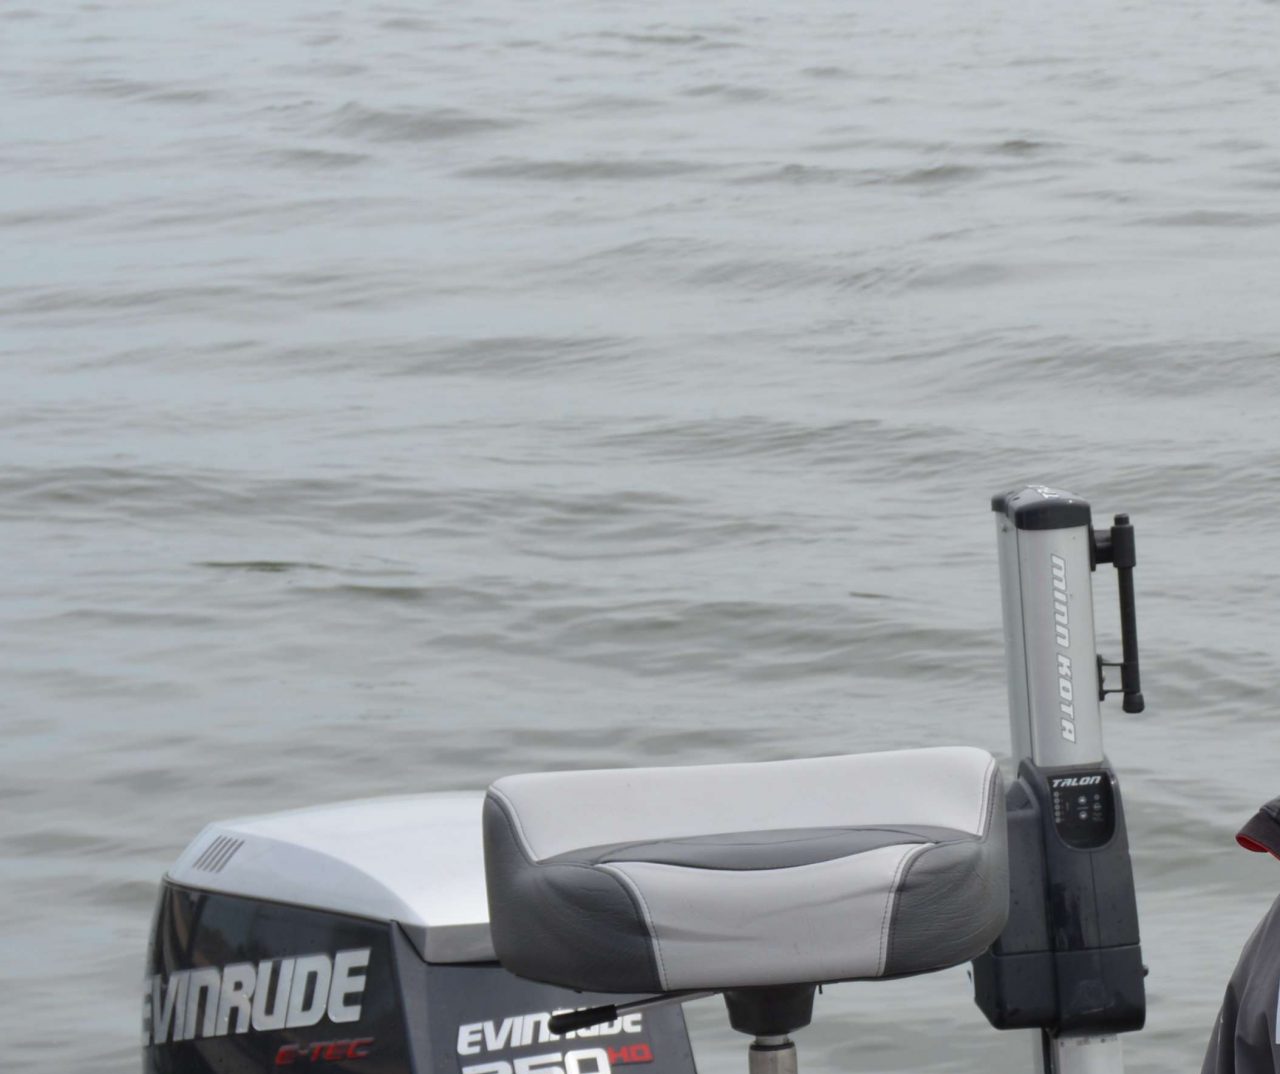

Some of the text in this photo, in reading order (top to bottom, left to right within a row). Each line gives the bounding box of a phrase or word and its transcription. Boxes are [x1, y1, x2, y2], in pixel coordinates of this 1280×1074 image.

[1051, 554, 1077, 744] MINN KOTA
[1052, 775, 1102, 788] TALON
[275, 1037, 375, 1066] E-TEC
